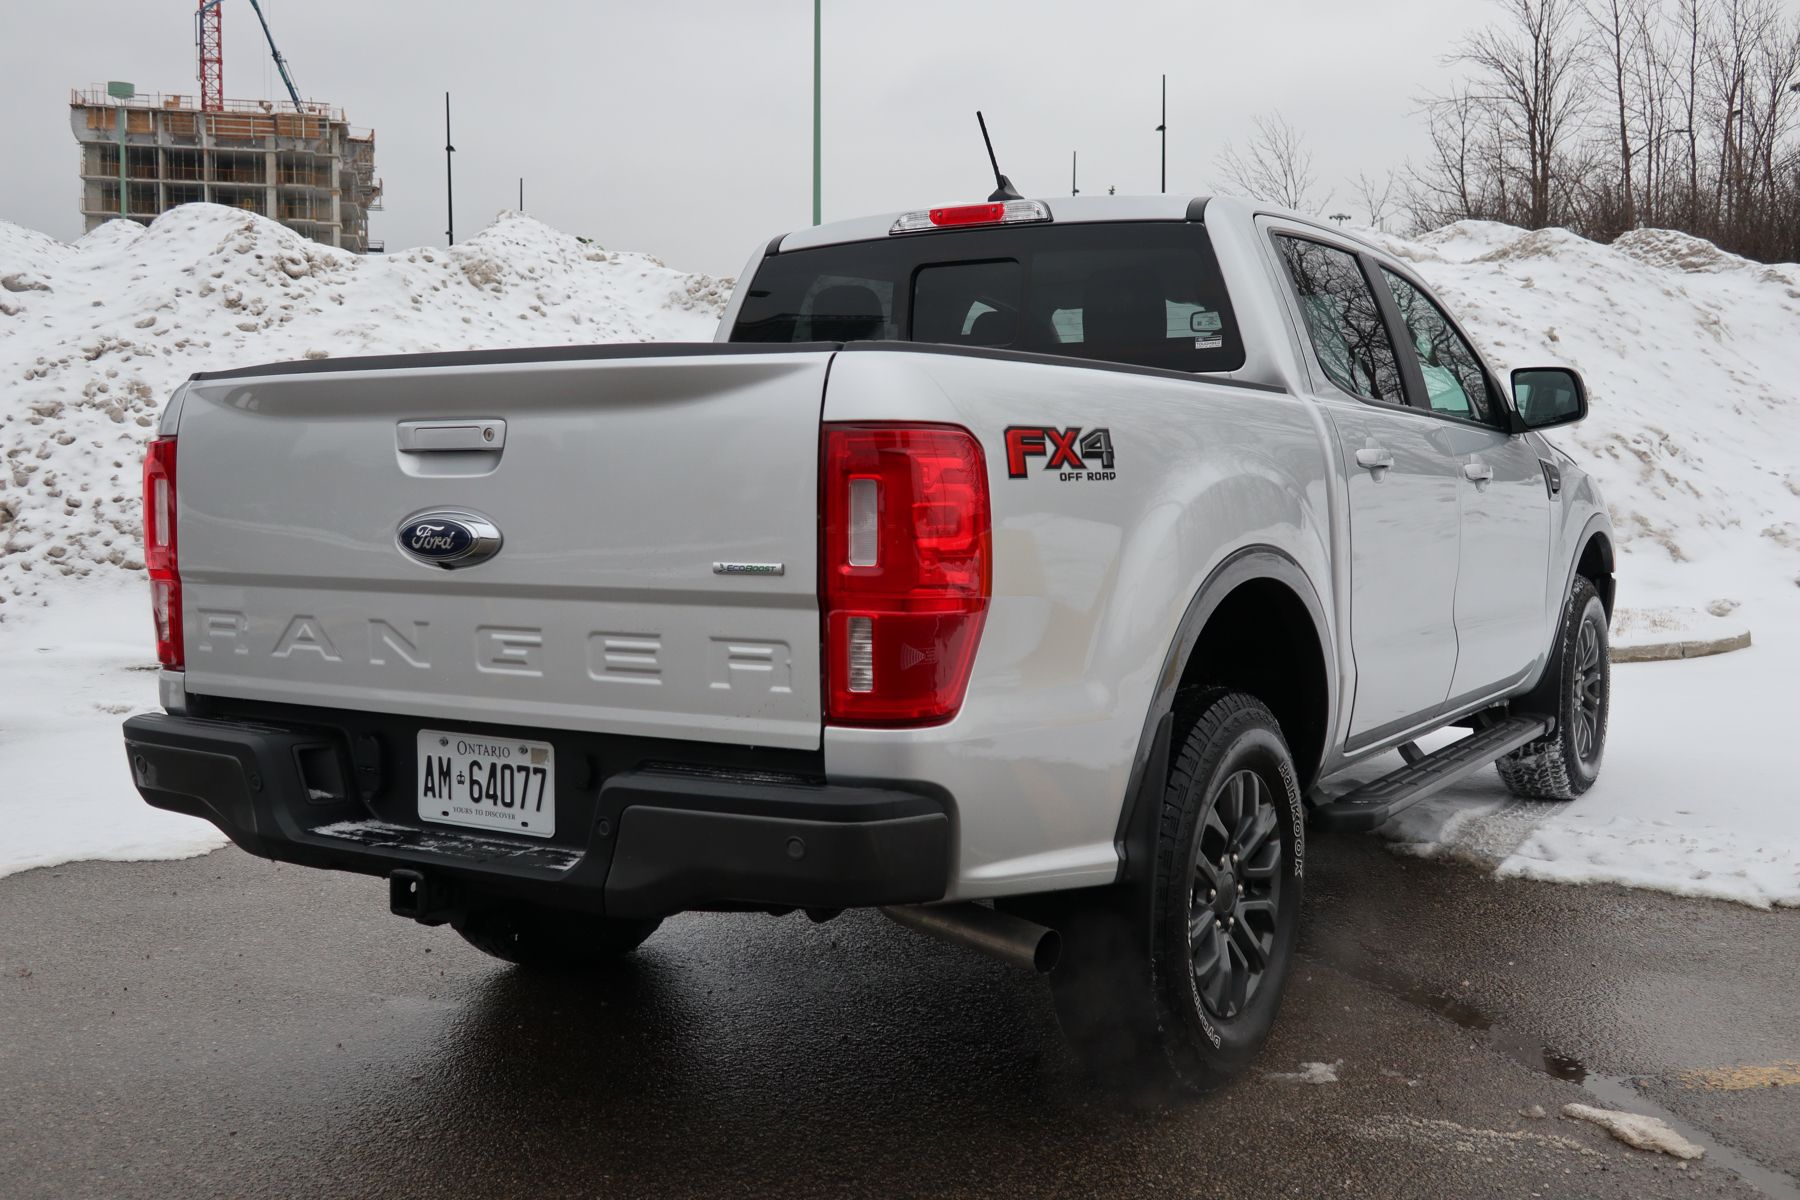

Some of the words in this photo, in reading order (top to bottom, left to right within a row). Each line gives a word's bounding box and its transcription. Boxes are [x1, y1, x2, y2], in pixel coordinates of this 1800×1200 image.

[1003, 425, 1115, 479] FX4
[1060, 472, 1083, 481] OFF
[1087, 471, 1116, 481] ROAD
[411, 524, 455, 549] Ford
[197, 607, 793, 694] RANGER
[457, 740, 511, 759] ONTARIO
[423, 754, 452, 800] AM
[469, 759, 547, 813] 64077
[453, 806, 473, 815] YOURS
[475, 808, 484, 816] TO
[484, 810, 516, 820] DISCOVER
